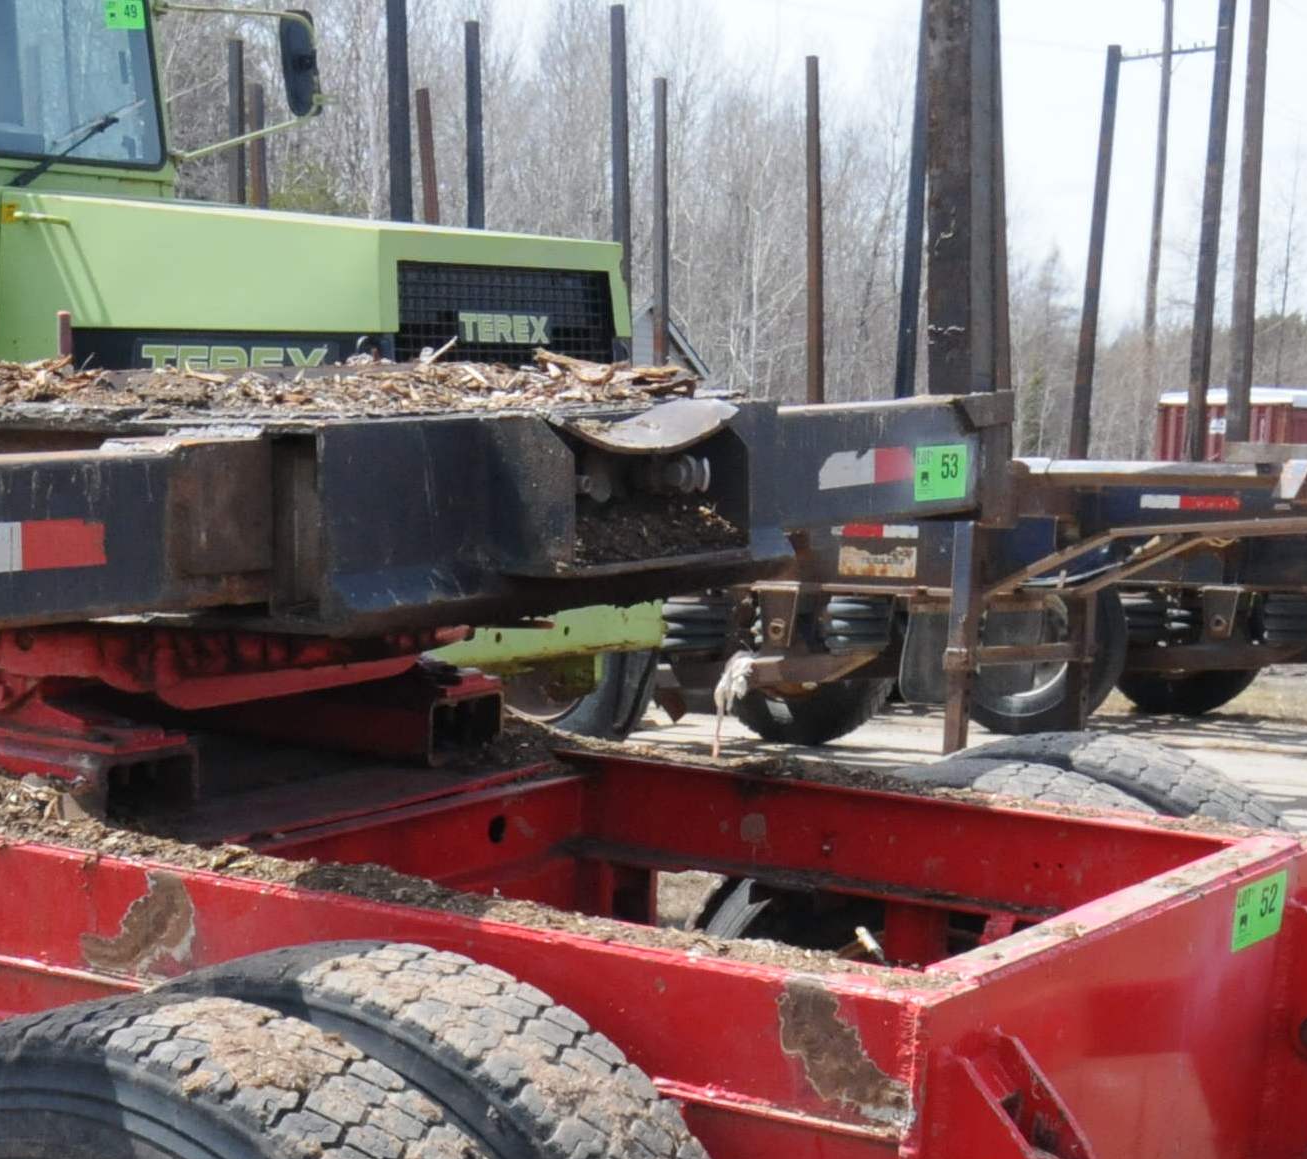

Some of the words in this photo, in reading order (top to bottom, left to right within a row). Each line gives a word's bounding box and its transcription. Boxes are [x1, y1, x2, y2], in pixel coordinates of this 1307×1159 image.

[123, 4, 138, 18] 49
[458, 312, 550, 344] TEREX
[941, 452, 959, 479] 53
[1259, 883, 1279, 918] 52
